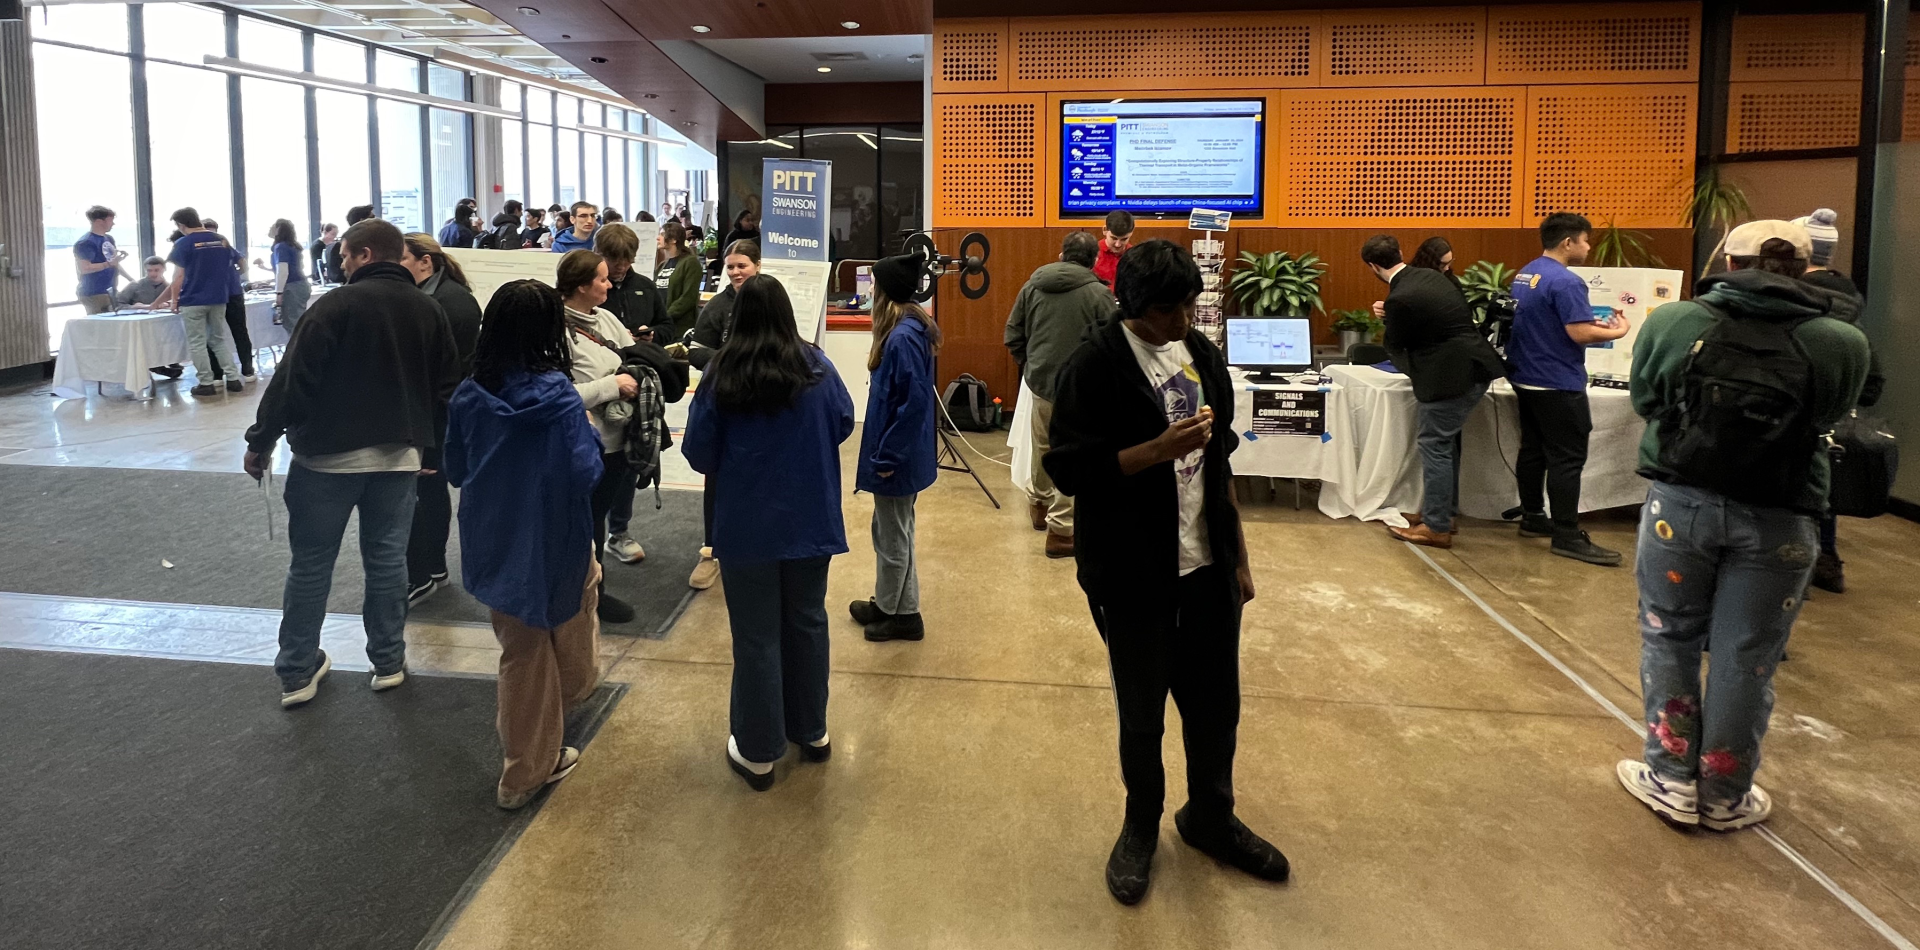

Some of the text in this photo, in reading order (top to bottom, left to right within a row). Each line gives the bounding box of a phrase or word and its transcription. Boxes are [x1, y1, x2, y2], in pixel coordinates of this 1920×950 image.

[1120, 123, 1139, 131] PITT
[773, 170, 816, 192] PITT
[772, 197, 816, 210] SWANSON
[772, 208, 816, 218] ENGINEERING
[768, 231, 819, 248] Welcome
[788, 249, 797, 258] to
[1275, 392, 1304, 400] SIGNALS
[1281, 401, 1296, 409] AND
[1258, 409, 1320, 418] COMMUNICATIONS
